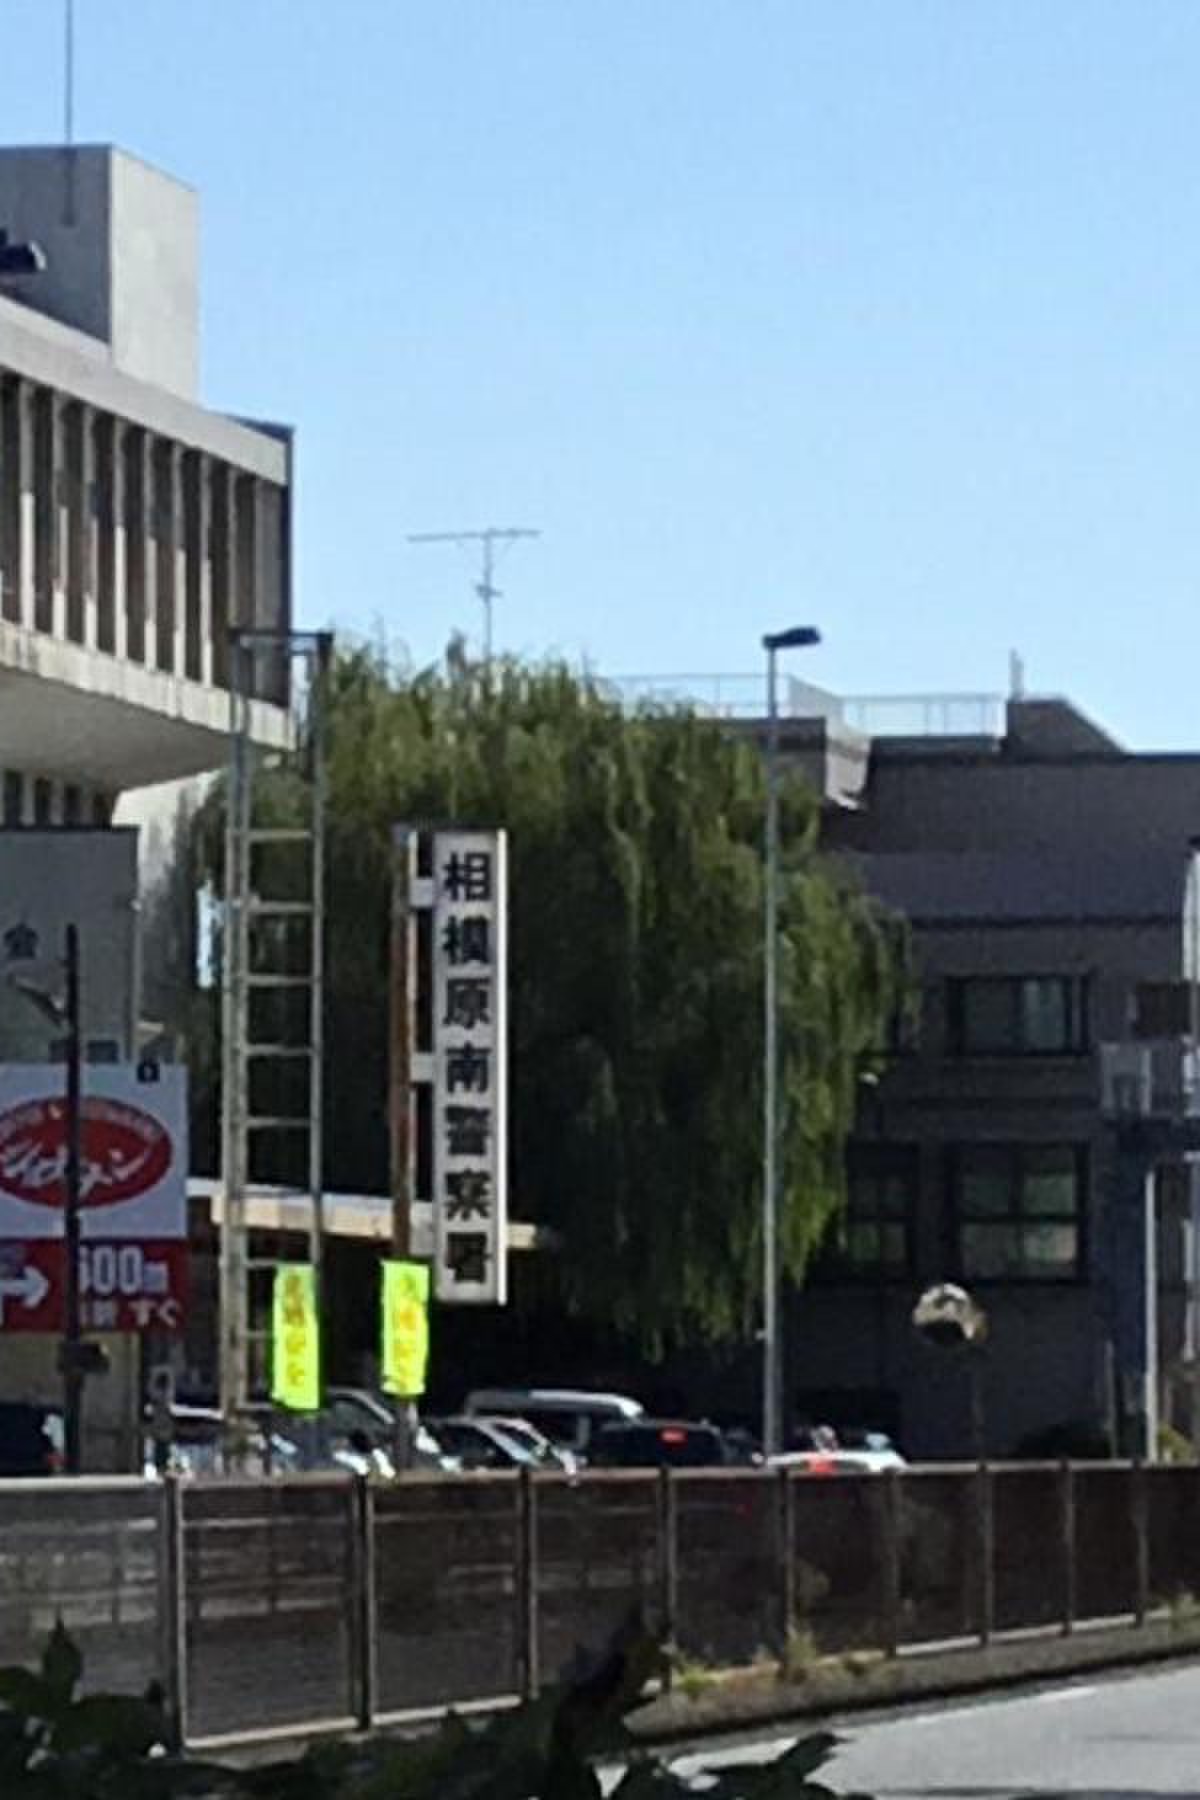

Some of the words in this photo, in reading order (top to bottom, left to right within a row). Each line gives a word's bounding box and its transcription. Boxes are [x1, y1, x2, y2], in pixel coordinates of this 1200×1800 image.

[442, 850, 491, 1285] 相模原南警察署
